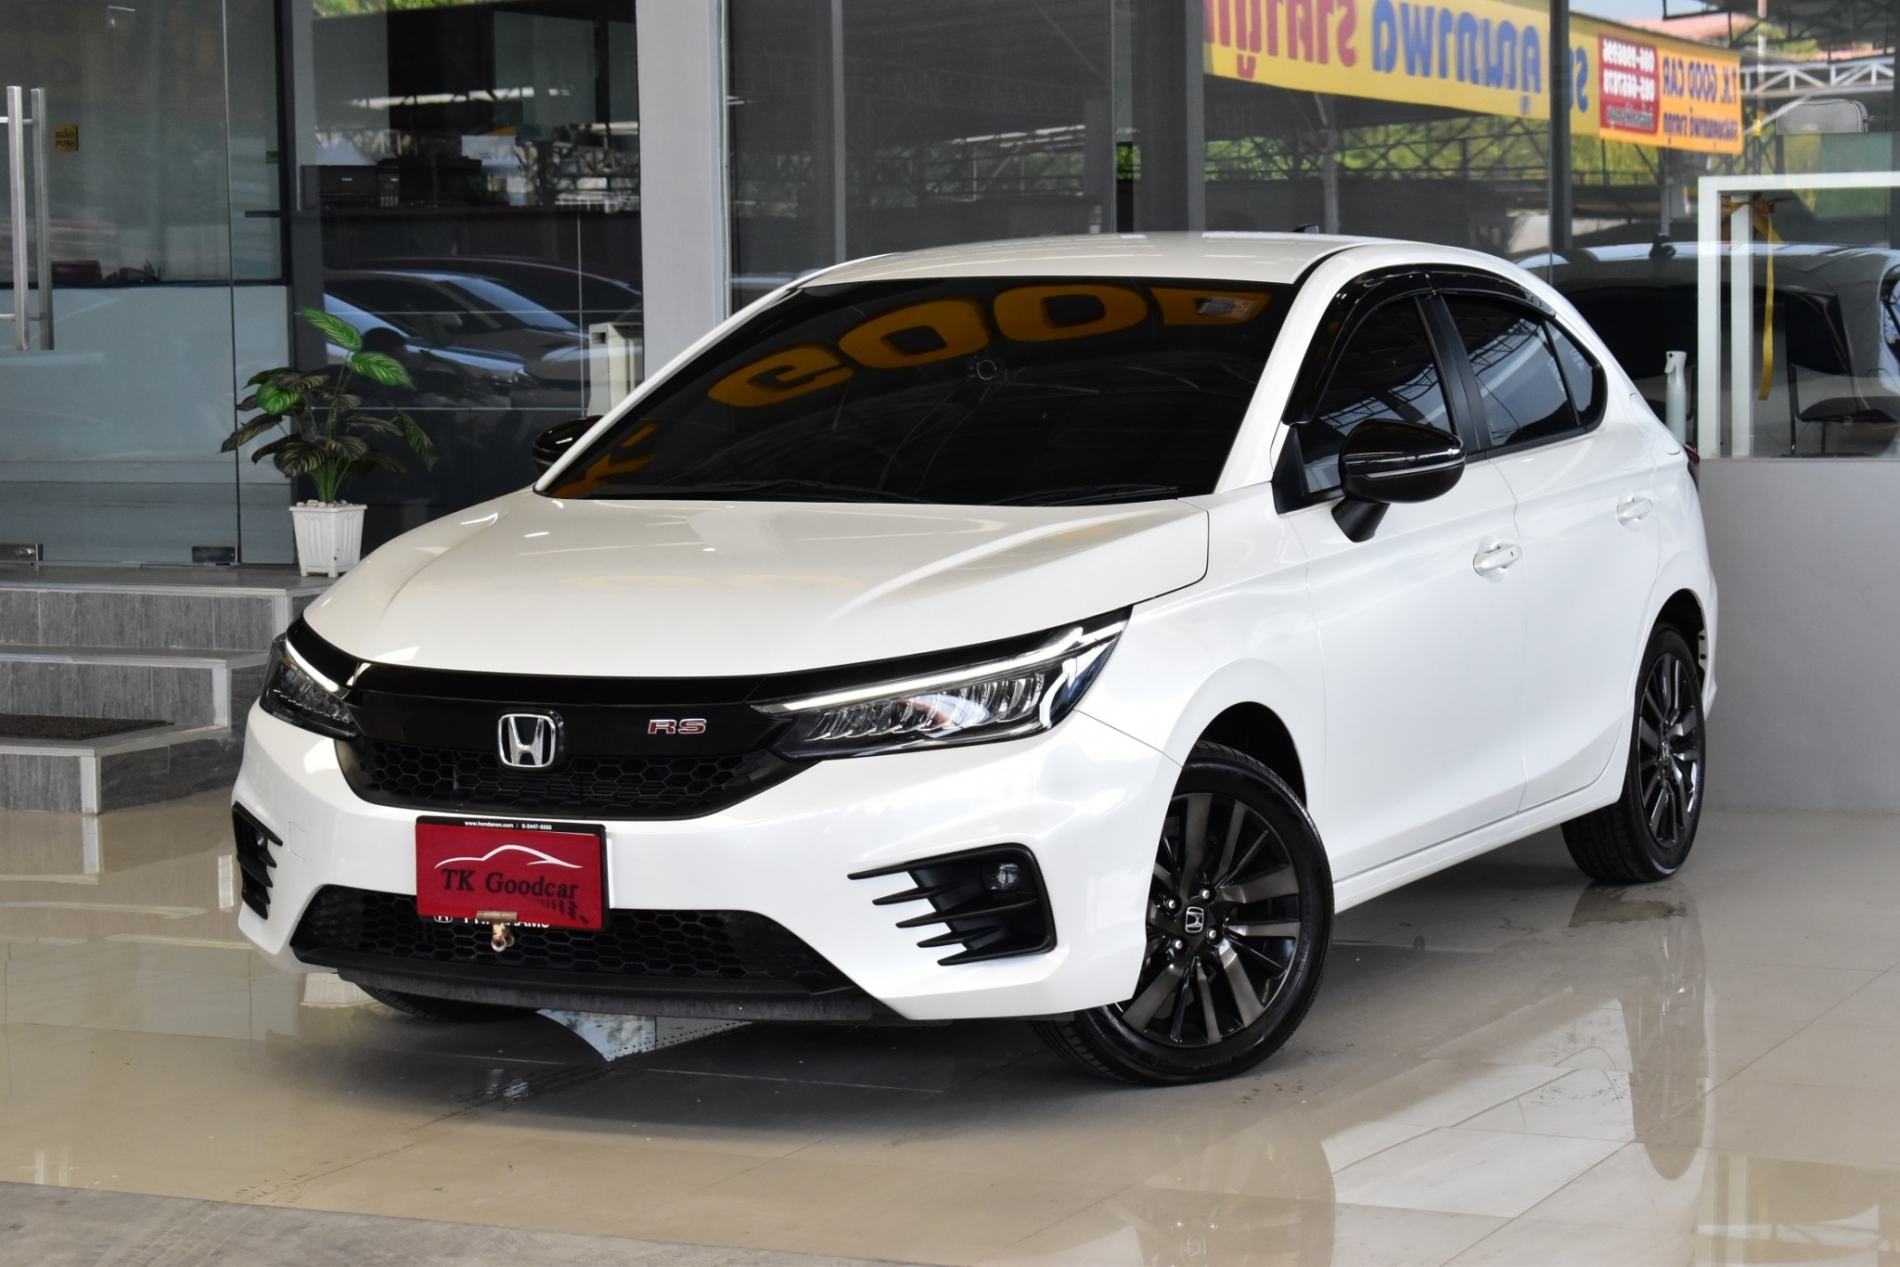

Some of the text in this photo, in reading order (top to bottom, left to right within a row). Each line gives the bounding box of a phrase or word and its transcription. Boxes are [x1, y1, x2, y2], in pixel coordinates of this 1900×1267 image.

[56, 139, 75, 147] PUSH
[648, 718, 707, 734] RS
[442, 868, 579, 899] TK Goodcar
